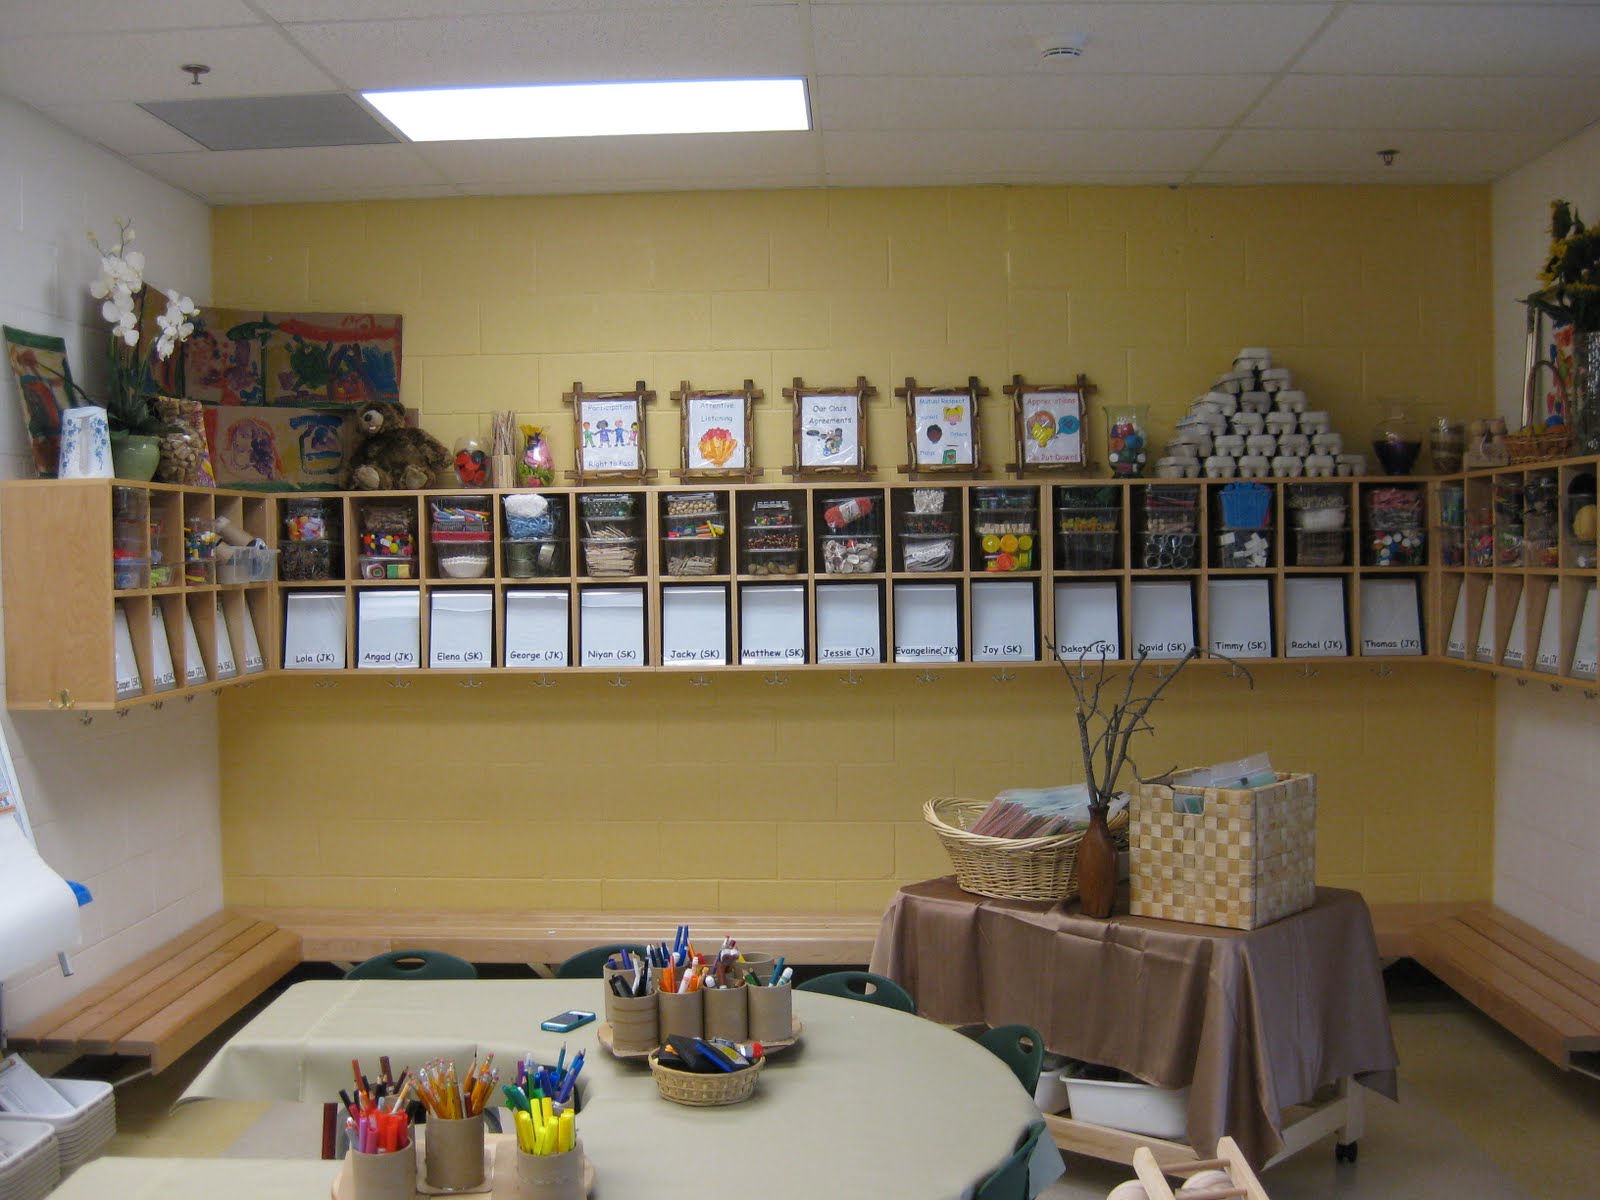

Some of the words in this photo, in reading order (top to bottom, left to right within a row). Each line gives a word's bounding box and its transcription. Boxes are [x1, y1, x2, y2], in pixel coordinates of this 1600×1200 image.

[809, 417, 852, 426] Agreements
[1061, 644, 1092, 653] Dakota
[1095, 644, 1116, 653] (SK)
[1138, 643, 1164, 652] David
[1167, 643, 1187, 652] (SK)
[1215, 641, 1244, 651] Timmy
[1247, 641, 1267, 650] (SK)
[1291, 640, 1320, 649] Rachel
[1323, 640, 1343, 649] (JK)
[1364, 640, 1398, 648] Thomas
[1400, 640, 1420, 649] (JK)
[588, 650, 613, 660] Niyan
[616, 650, 636, 659] (SK)
[670, 650, 697, 659] Jacky
[700, 650, 720, 659] (SK)
[742, 649, 782, 657] Matthew
[784, 649, 804, 657] (SK)
[823, 648, 852, 657] Jessie
[855, 647, 875, 657] (JK)
[982, 645, 999, 655] Joy
[1002, 645, 1023, 654] (SK)
[295, 655, 313, 663] Lola
[316, 653, 335, 663] (JK)
[364, 652, 391, 662] Angad
[394, 652, 414, 662] (JK)
[437, 652, 460, 661] Elena
[463, 651, 483, 661] (SK)
[510, 651, 541, 661] George
[544, 651, 564, 661] (JK)
